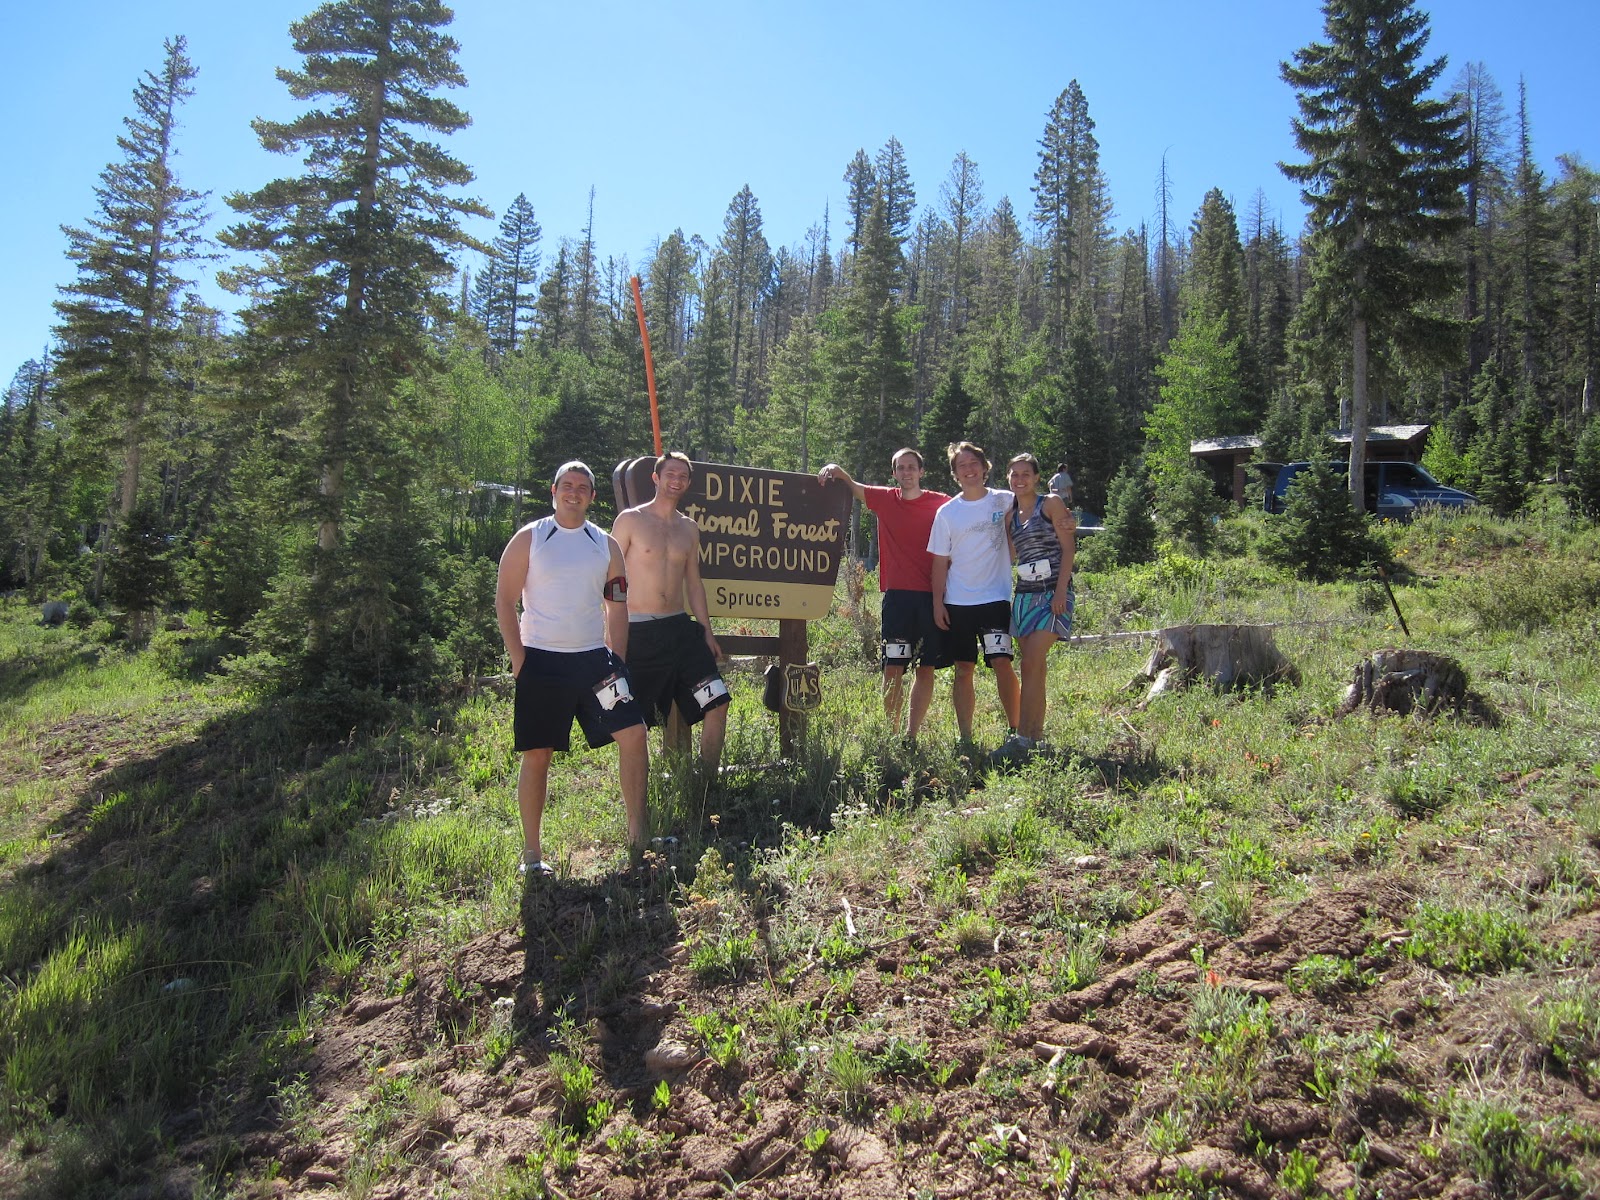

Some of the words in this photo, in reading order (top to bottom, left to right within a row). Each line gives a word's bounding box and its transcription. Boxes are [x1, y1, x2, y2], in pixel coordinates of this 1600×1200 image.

[706, 473, 784, 507] DIXIE
[684, 503, 760, 537] tional
[771, 513, 840, 543] Forest
[697, 542, 831, 573] MPGROUND
[1029, 562, 1036, 574] 7
[716, 586, 781, 609] Spruces
[994, 634, 1002, 645] 7
[898, 644, 905, 656] 7
[608, 682, 620, 698] 7
[703, 684, 714, 699] 7
